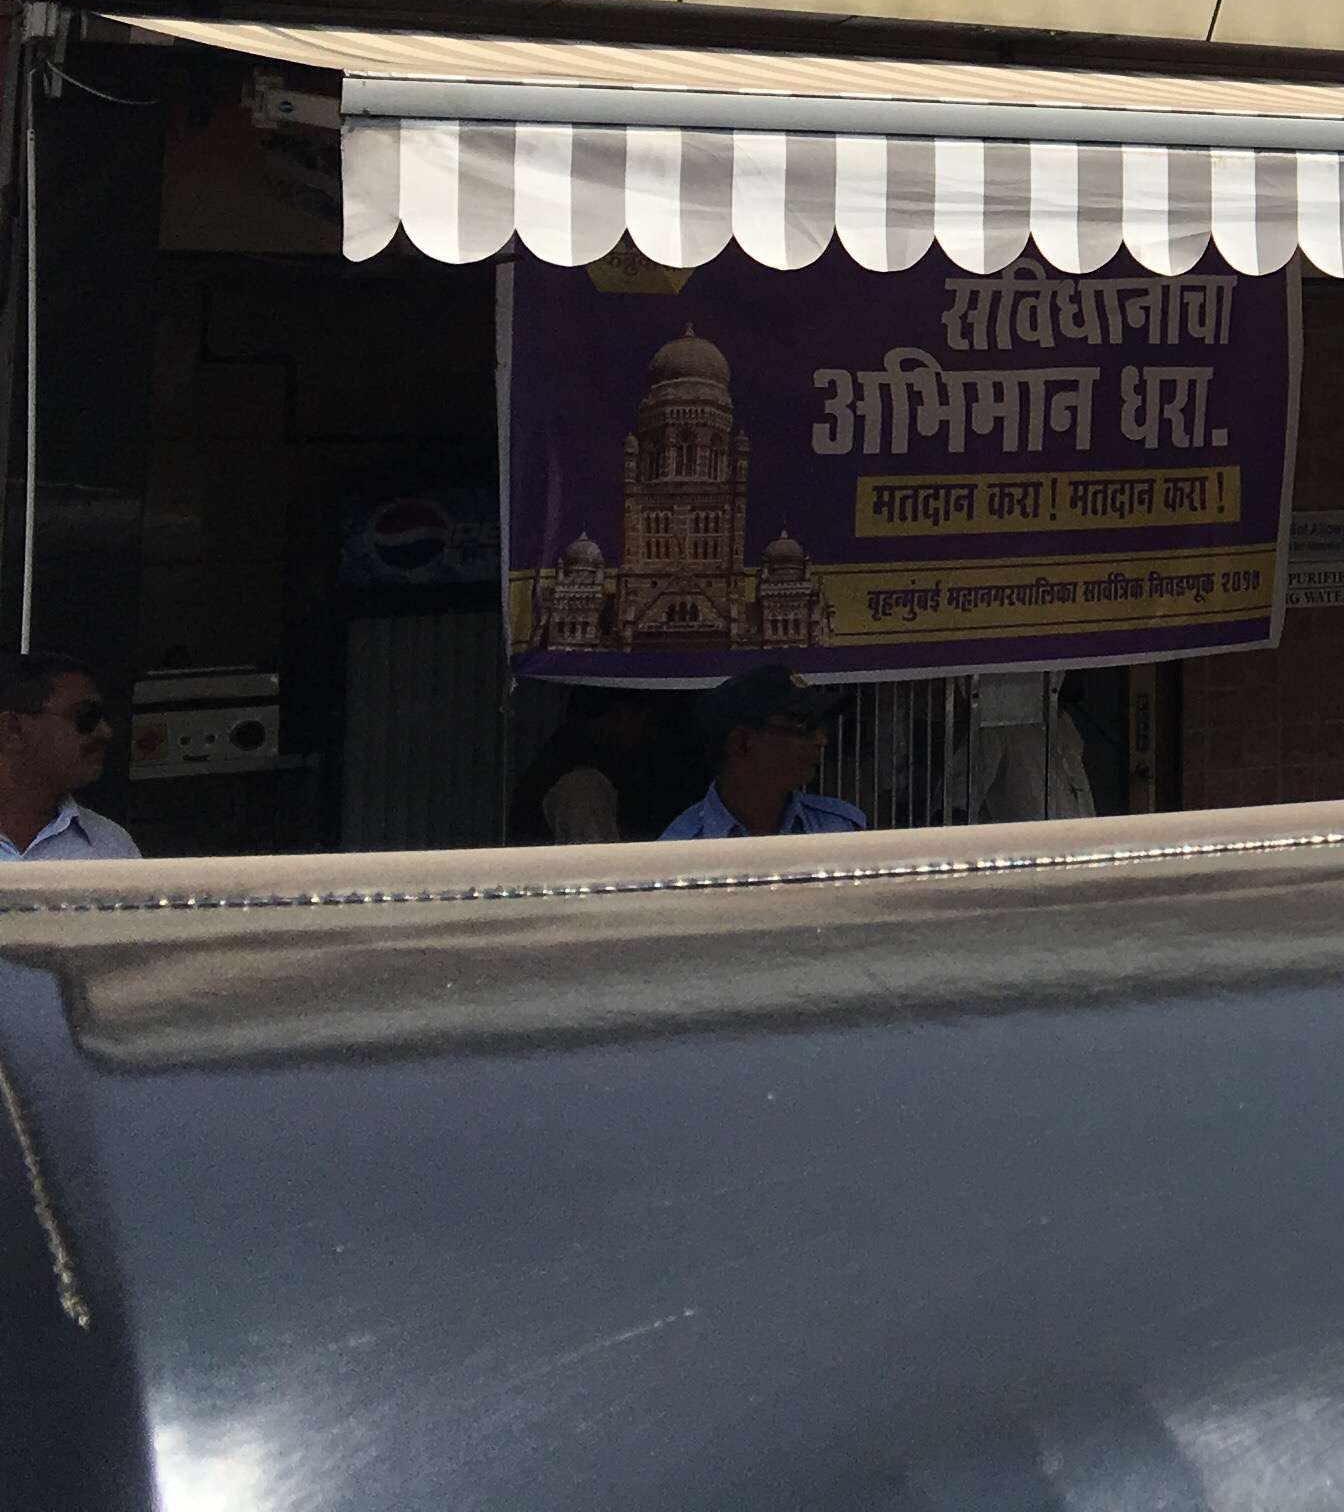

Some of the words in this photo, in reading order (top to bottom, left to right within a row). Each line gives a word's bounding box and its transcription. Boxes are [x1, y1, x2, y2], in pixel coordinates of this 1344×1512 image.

[812, 346, 1101, 455] अभिमान
[1120, 365, 1229, 449] धरा.
[872, 482, 978, 526] मतदान
[1069, 476, 1156, 518] मतदान
